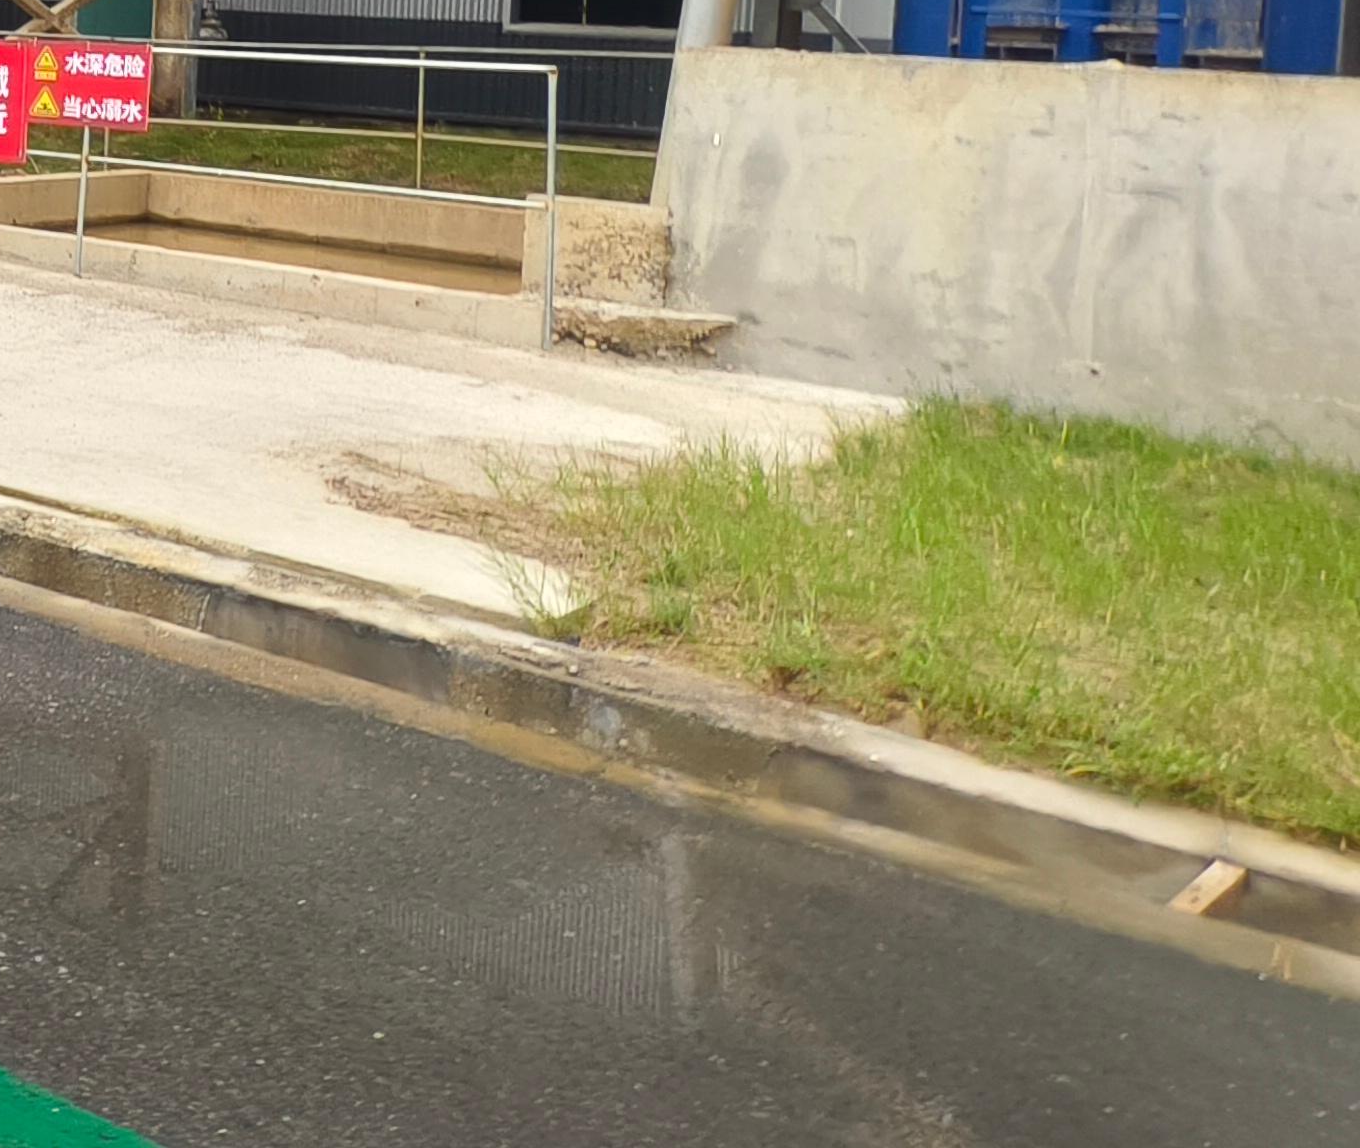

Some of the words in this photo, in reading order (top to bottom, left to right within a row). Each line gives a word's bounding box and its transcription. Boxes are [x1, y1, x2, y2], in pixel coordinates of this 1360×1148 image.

[64, 50, 146, 79] 水深危险
[62, 94, 144, 124] 当心溺水
